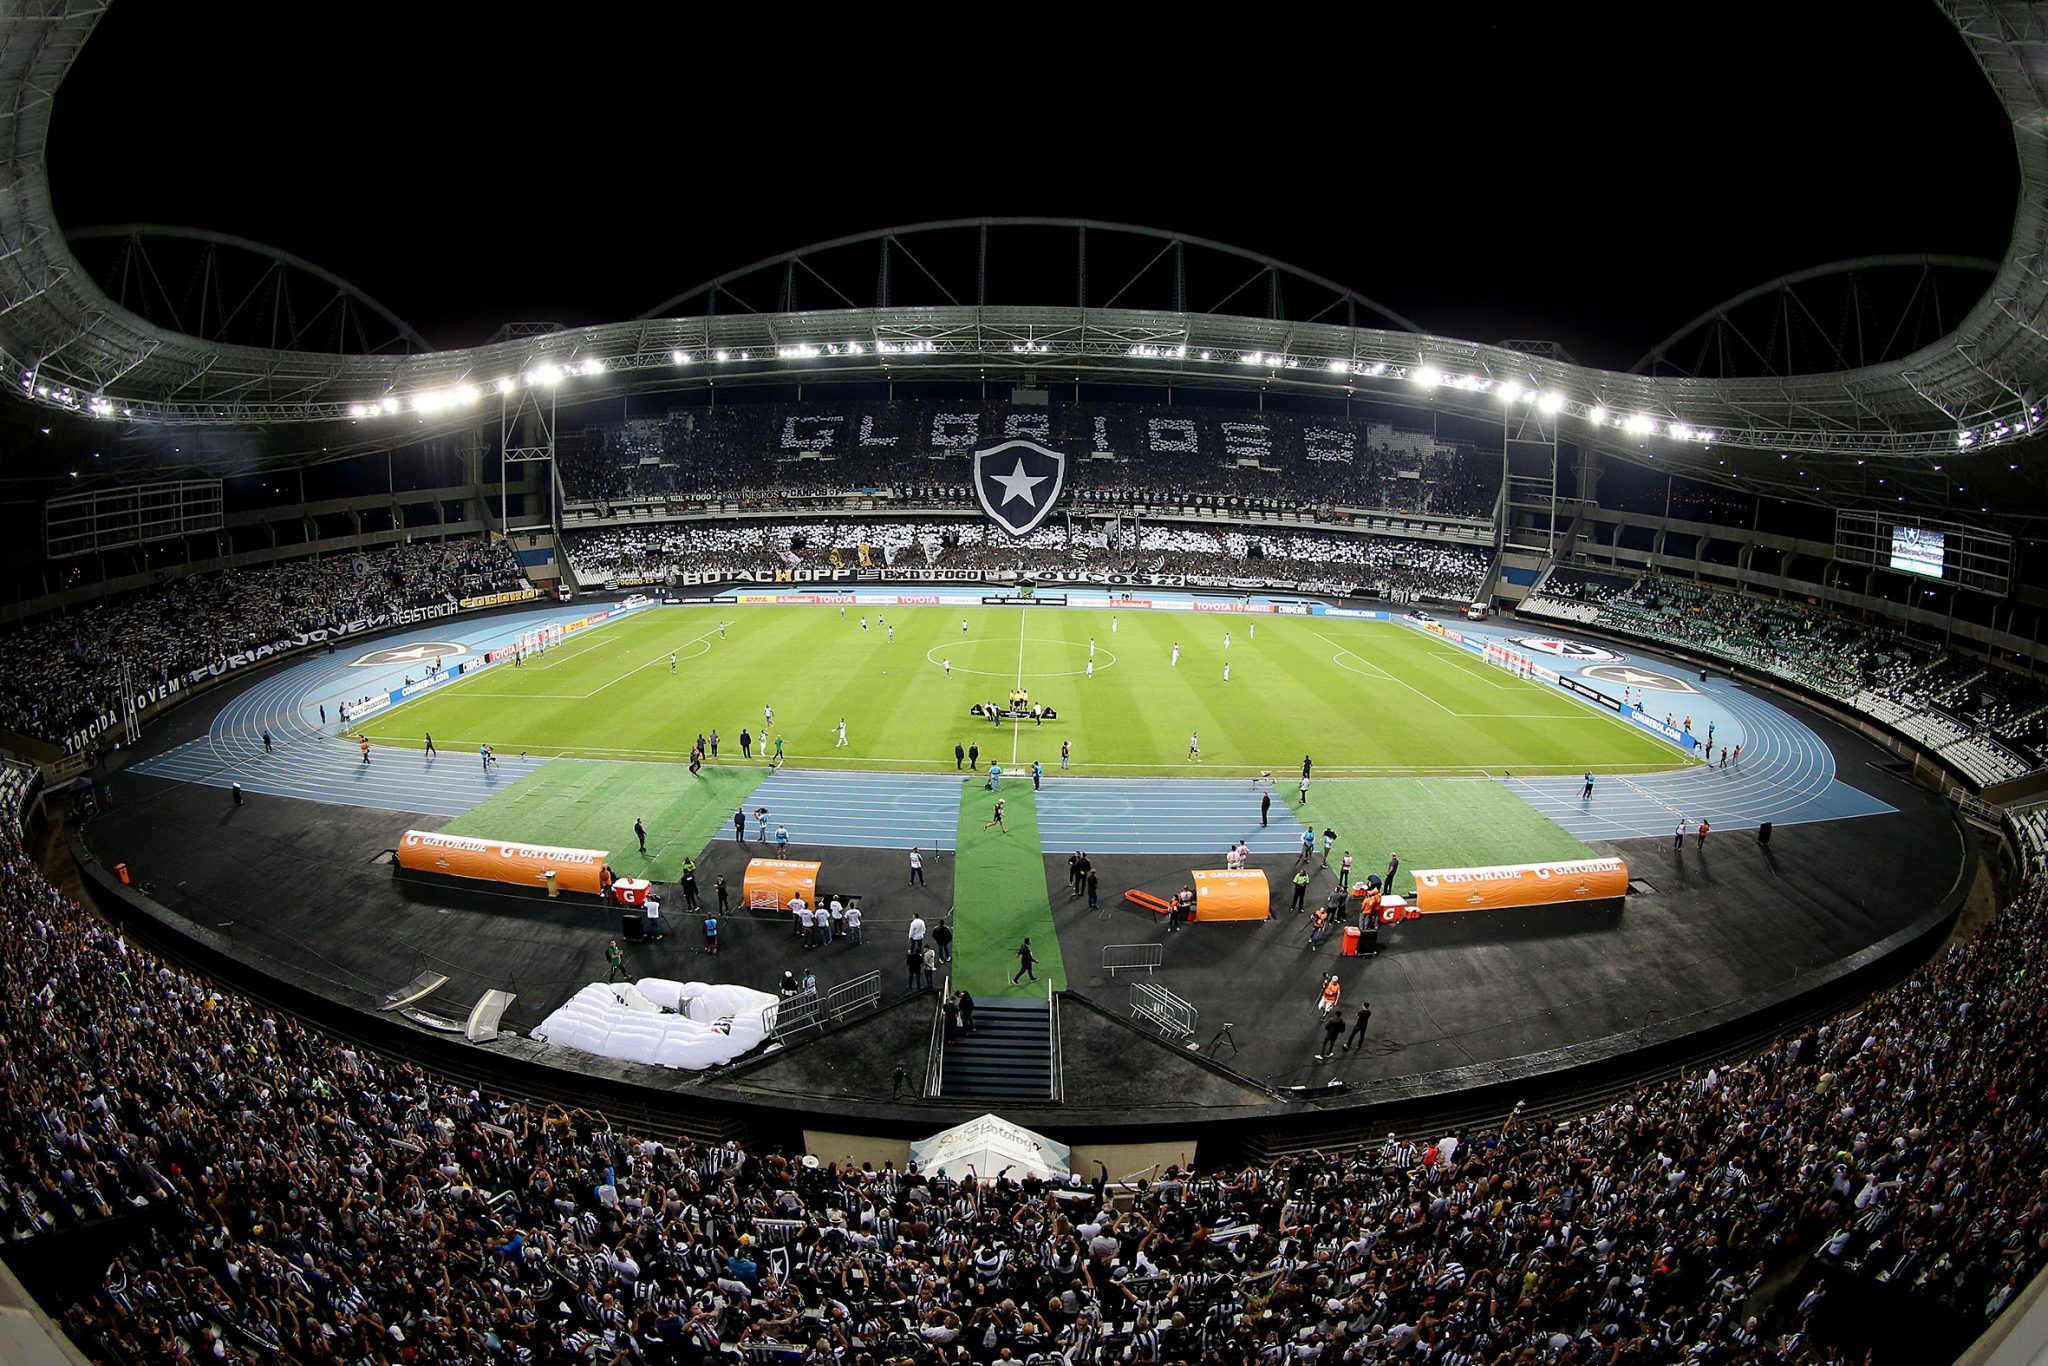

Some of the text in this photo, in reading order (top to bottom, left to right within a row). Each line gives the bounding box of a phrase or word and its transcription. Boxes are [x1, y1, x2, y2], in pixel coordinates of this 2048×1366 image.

[726, 491, 780, 501] ALVINEGROS
[616, 578, 654, 586] FOGORO-ES
[683, 569, 851, 586] BOTACHOPP
[934, 570, 979, 580] FOGO
[901, 596, 937, 604] TOYOTA
[1196, 602, 1231, 611] TOYOTA
[393, 600, 459, 625] RESISTENCIA
[1324, 608, 1377, 618] CONMEBOL.COM
[292, 615, 386, 646] JOVEM
[491, 645, 516, 661] TOYOTA
[401, 671, 450, 697] CONMEBOL.COM
[66, 677, 181, 754] TORCIDA JOVEM
[1631, 710, 1682, 742] CONMEBOL.COM
[422, 836, 488, 853] GATORADE
[519, 848, 595, 864] GATORADE
[764, 861, 818, 869] GATORADE
[1443, 869, 1522, 883] GATORADE
[1554, 861, 1621, 875] GATORADE
[623, 889, 636, 903] G
[1383, 908, 1395, 920] G
